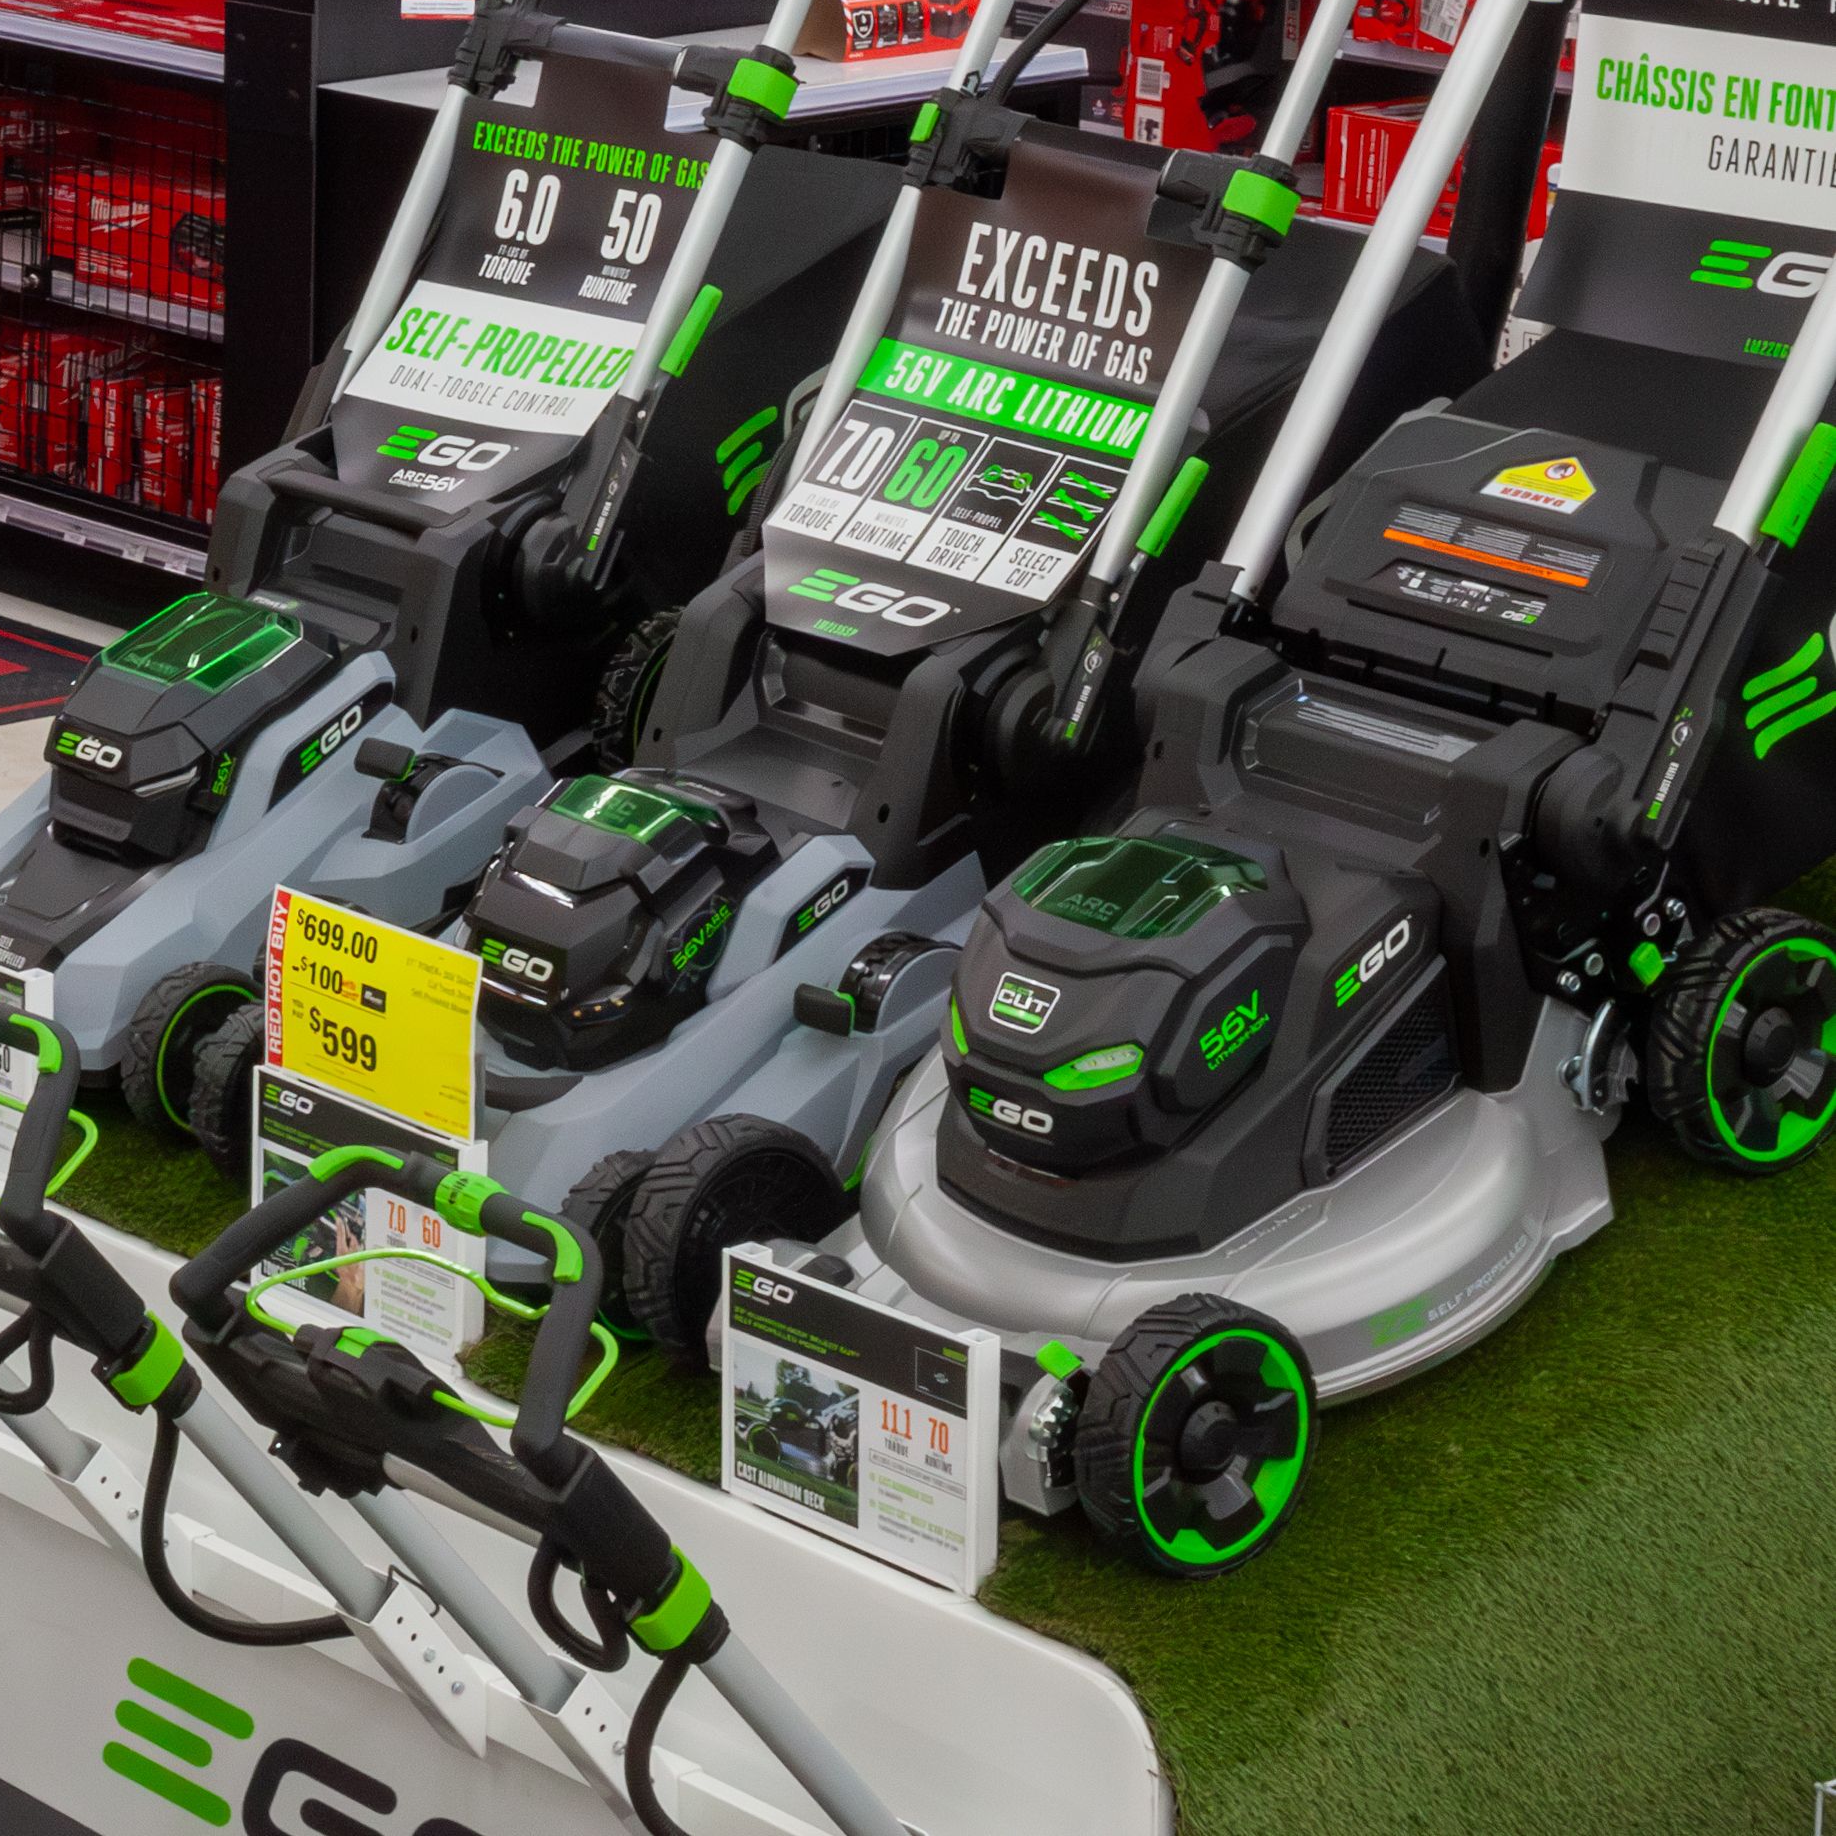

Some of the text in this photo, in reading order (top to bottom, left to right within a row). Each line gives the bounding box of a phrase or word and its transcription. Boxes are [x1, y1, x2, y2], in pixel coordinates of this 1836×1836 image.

[1596, 53, 1761, 121] CHÂSSIS EN
[474, 121, 672, 184] EXCEEDS THE POWER OF
[495, 169, 561, 245] 6.0
[600, 189, 662, 265] 50
[478, 254, 535, 286] TORQUE
[578, 274, 636, 305] RUNTIME
[956, 221, 1159, 337] EXCEEDS
[385, 307, 635, 390] SELF-PROPELLED
[934, 297, 1153, 386] THE POWER OF GAS
[389, 364, 576, 417] DUAL-TOGGLE CONTROL
[885, 350, 1149, 450] 56V ARC LITHIUM
[378, 425, 513, 471] EGO
[815, 418, 896, 491] 7.0
[420, 472, 464, 493] 56V
[883, 437, 969, 510] 60
[783, 503, 839, 531] TORQUE
[846, 519, 913, 554] RUNTIME
[939, 526, 984, 554] TOUCH
[951, 505, 1003, 529] SELF-PROPEL
[927, 543, 972, 571] DRIVE
[1004, 566, 1038, 589] CUT
[1008, 547, 1062, 575] SELECT
[787, 568, 952, 626] EGO
[57, 731, 122, 769] EGO
[299, 705, 363, 775] EGO
[296, 907, 378, 964] $699.00
[672, 924, 707, 971] 56V
[267, 902, 289, 1055] RED HOT BUY
[291, 956, 344, 996] -$100
[480, 938, 554, 983] EGO
[1335, 919, 1411, 1008] EGO
[997, 987, 1050, 1014] CUT
[1199, 990, 1260, 1058] 56V
[309, 1007, 377, 1074] $599
[968, 1087, 1054, 1134] EGO
[422, 1216, 441, 1250] 60
[734, 1269, 795, 1304] EGO
[928, 1416, 949, 1456] 70
[736, 1461, 826, 1512] CAST ALUMINUM DECK
